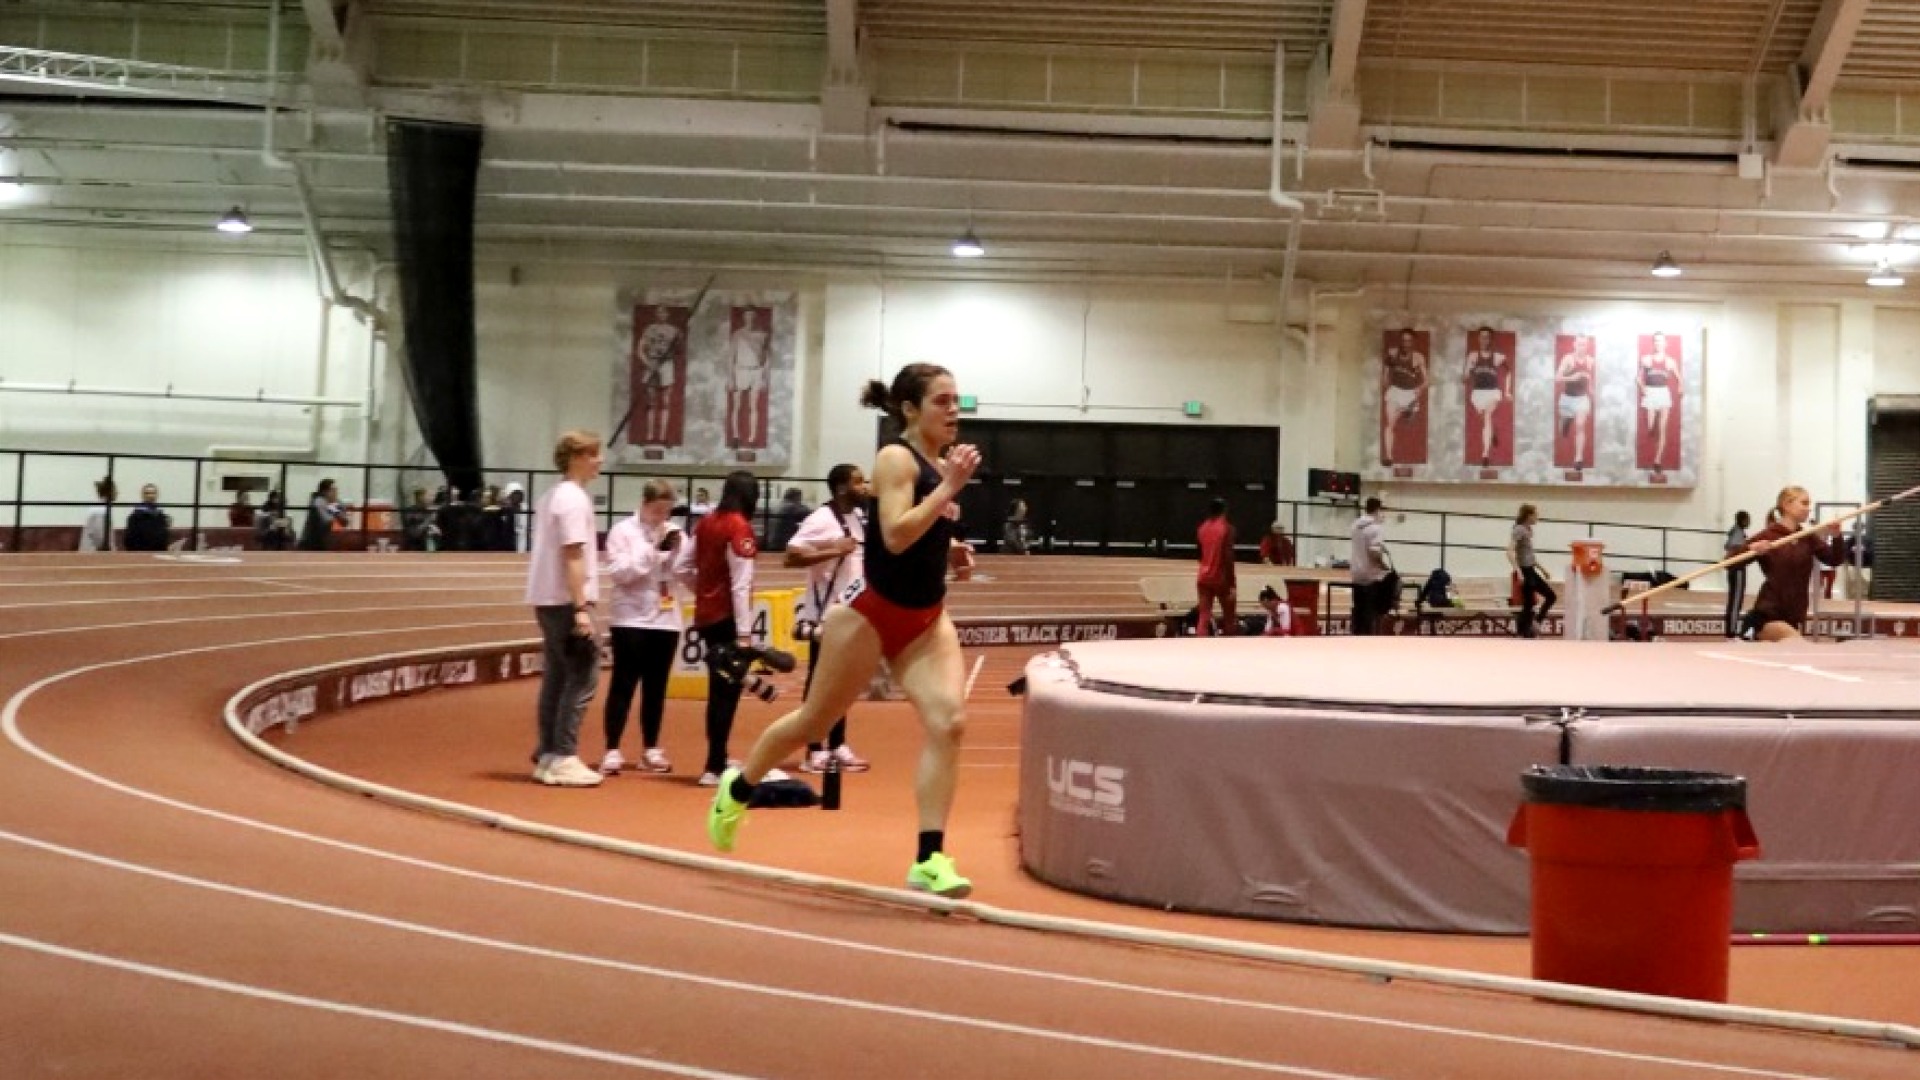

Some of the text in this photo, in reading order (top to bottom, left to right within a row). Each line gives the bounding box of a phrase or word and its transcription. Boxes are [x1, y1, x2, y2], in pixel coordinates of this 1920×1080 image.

[751, 609, 767, 641] 4
[682, 627, 703, 664] 8
[1047, 755, 1124, 806] UCS
